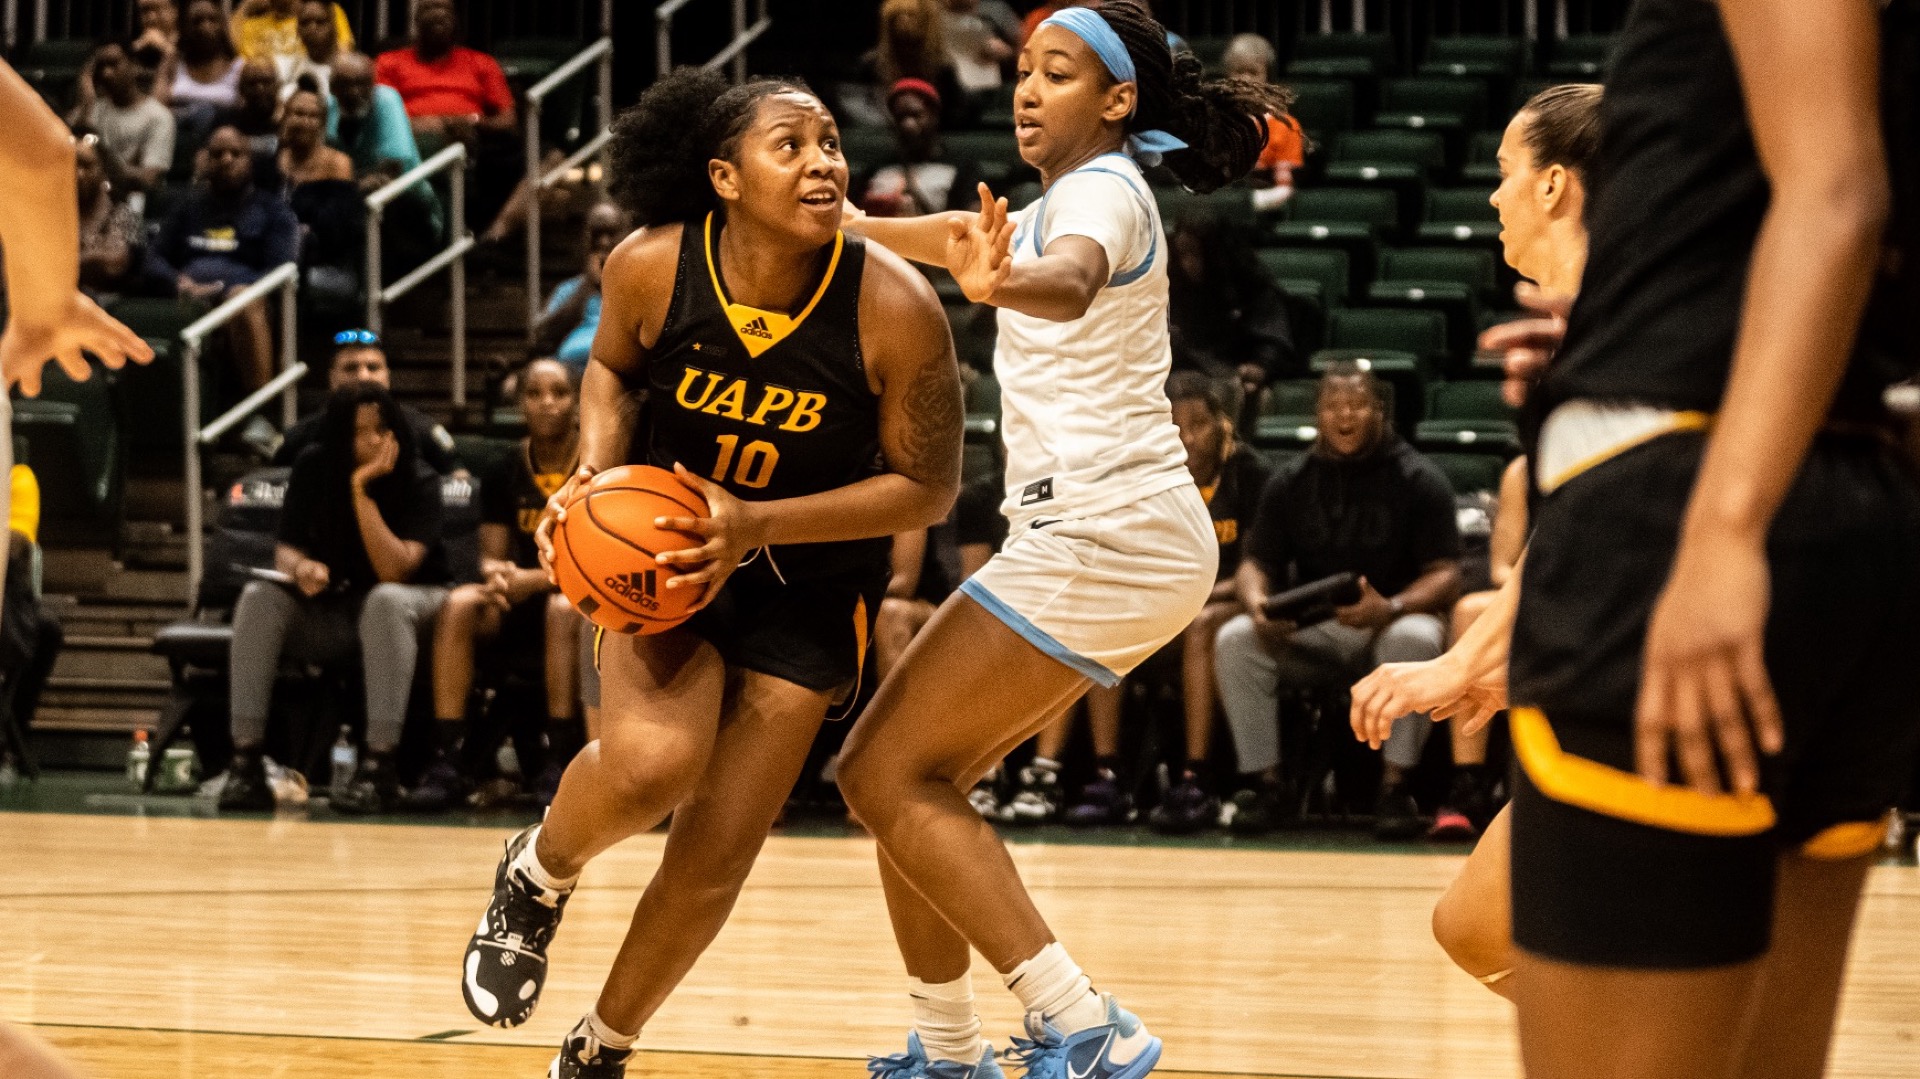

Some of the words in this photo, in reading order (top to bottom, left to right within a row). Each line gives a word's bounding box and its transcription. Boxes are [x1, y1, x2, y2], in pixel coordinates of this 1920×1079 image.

[740, 326, 773, 340] adidas
[676, 366, 828, 433] UAPB
[710, 433, 780, 489] 10
[604, 577, 660, 612] adidas
